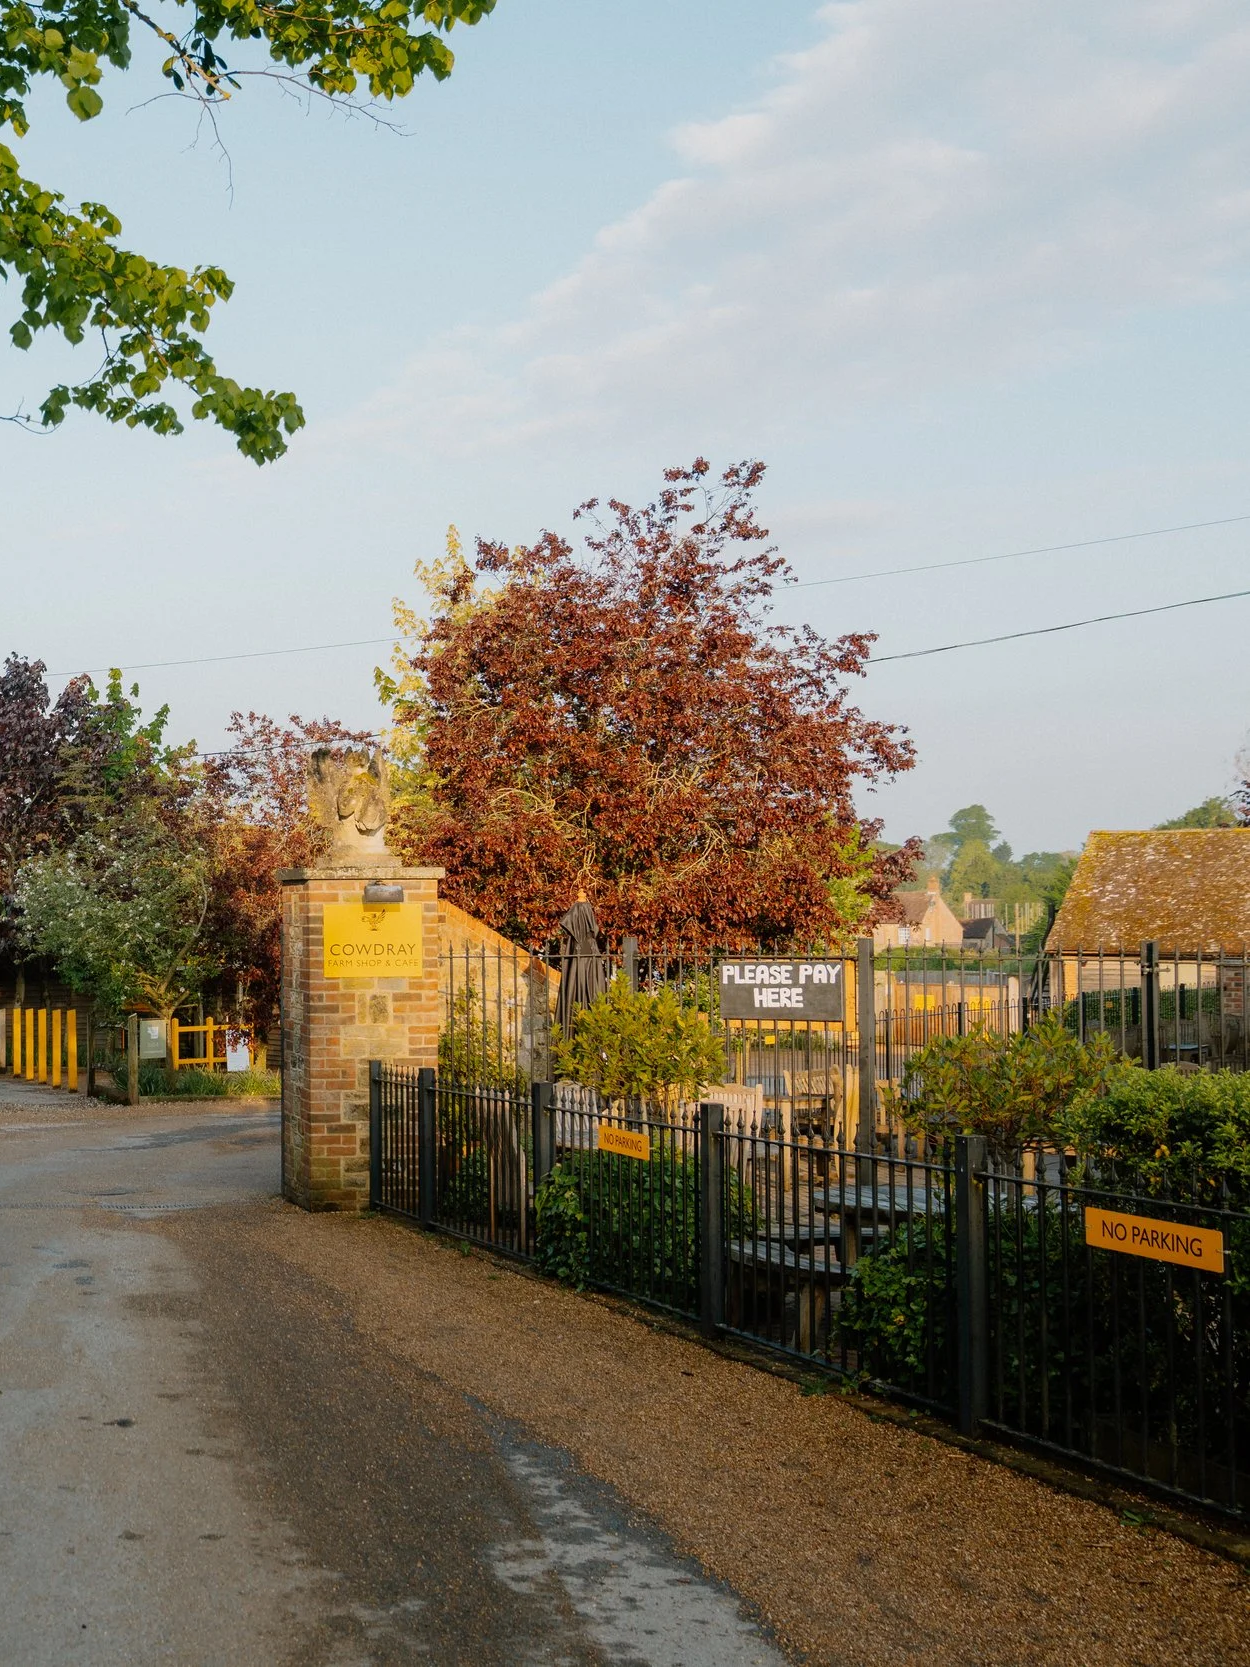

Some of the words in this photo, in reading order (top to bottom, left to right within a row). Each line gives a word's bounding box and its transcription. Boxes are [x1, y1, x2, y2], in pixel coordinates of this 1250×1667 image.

[330, 944, 416, 956] COWDRAY
[328, 960, 353, 968] FARM
[356, 960, 382, 968] SHOP
[385, 960, 391, 968] &
[722, 964, 793, 984] PLEASE
[799, 964, 841, 984] PAY
[753, 987, 804, 1008] HERE
[604, 1132, 615, 1145] NO
[615, 1135, 642, 1152] PARKING
[1102, 1219, 1127, 1241] NO
[1132, 1226, 1203, 1257] PARKING
